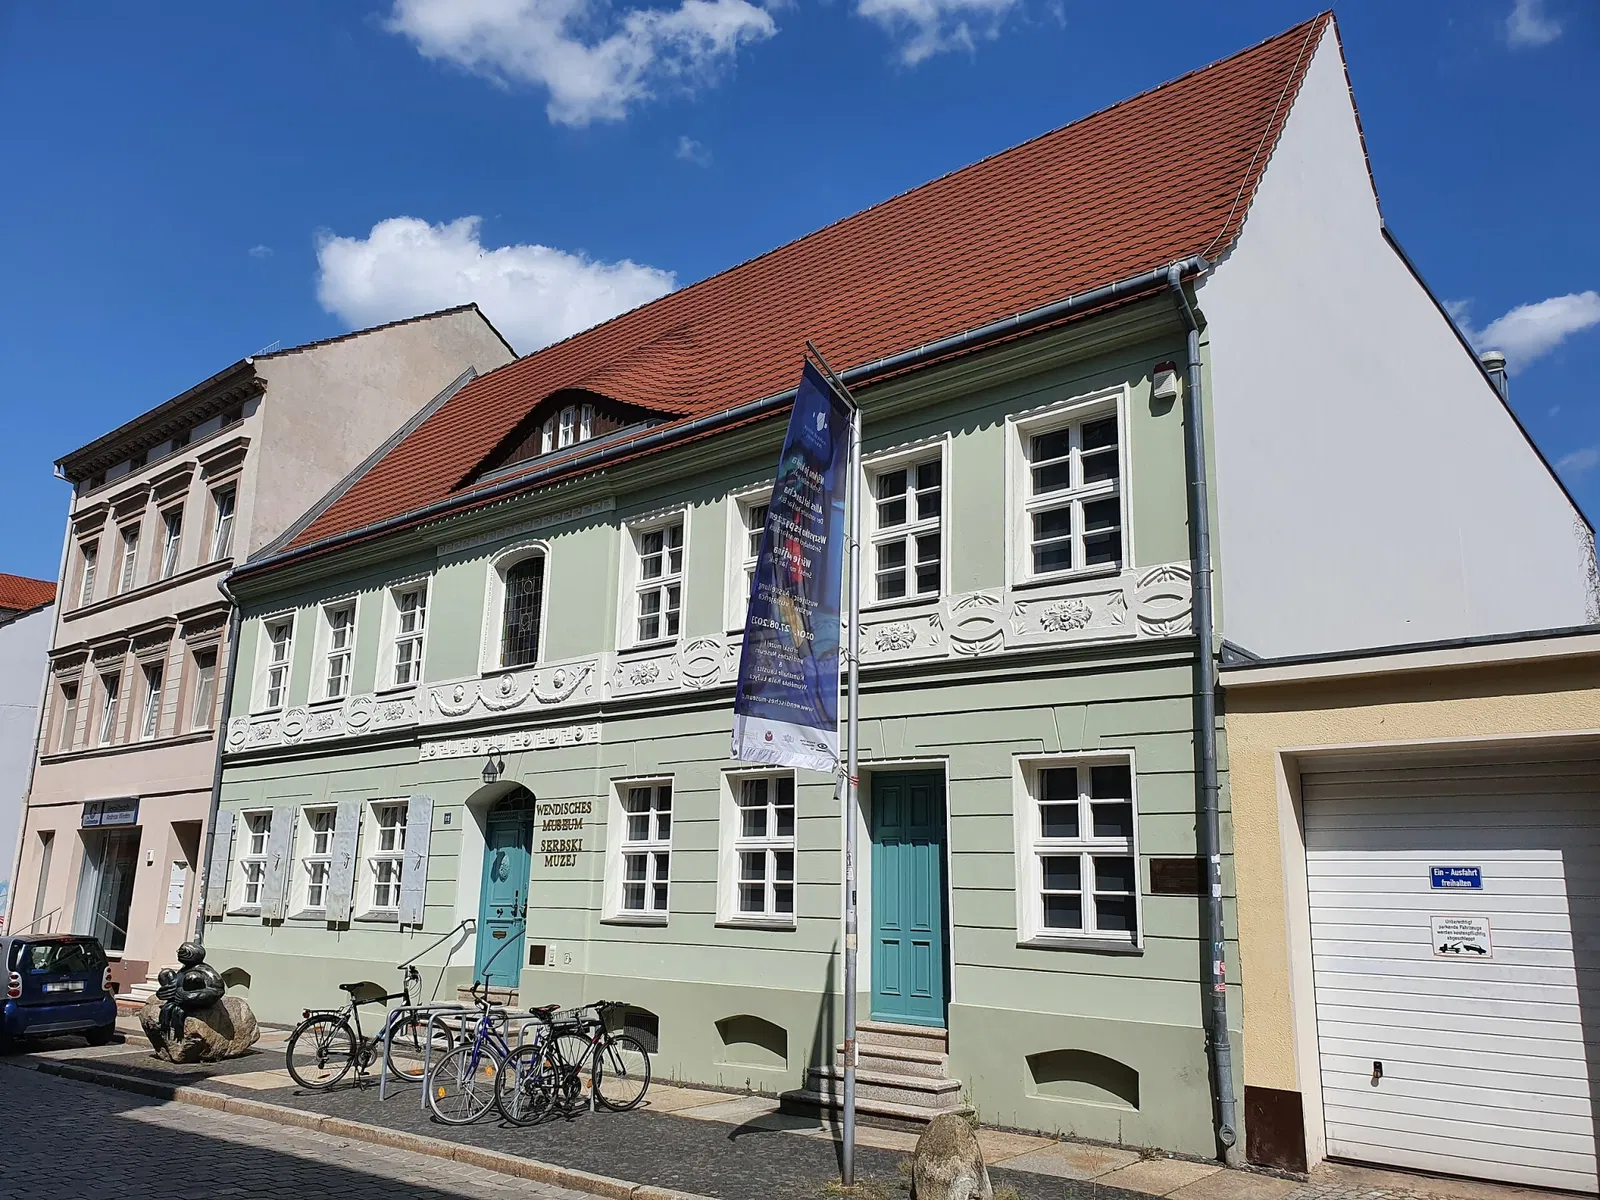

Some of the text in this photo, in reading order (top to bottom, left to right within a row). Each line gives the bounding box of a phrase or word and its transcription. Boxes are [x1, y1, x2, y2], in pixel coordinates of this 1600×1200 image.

[536, 801, 592, 816] WENDISCHES
[541, 818, 584, 832] MUSEUM
[540, 838, 584, 852] SERBSKI
[544, 854, 577, 868] MUZEJ
[1433, 868, 1444, 876] Ein
[1450, 868, 1478, 877] Ausfahrt
[1441, 879, 1472, 887] freihalten
